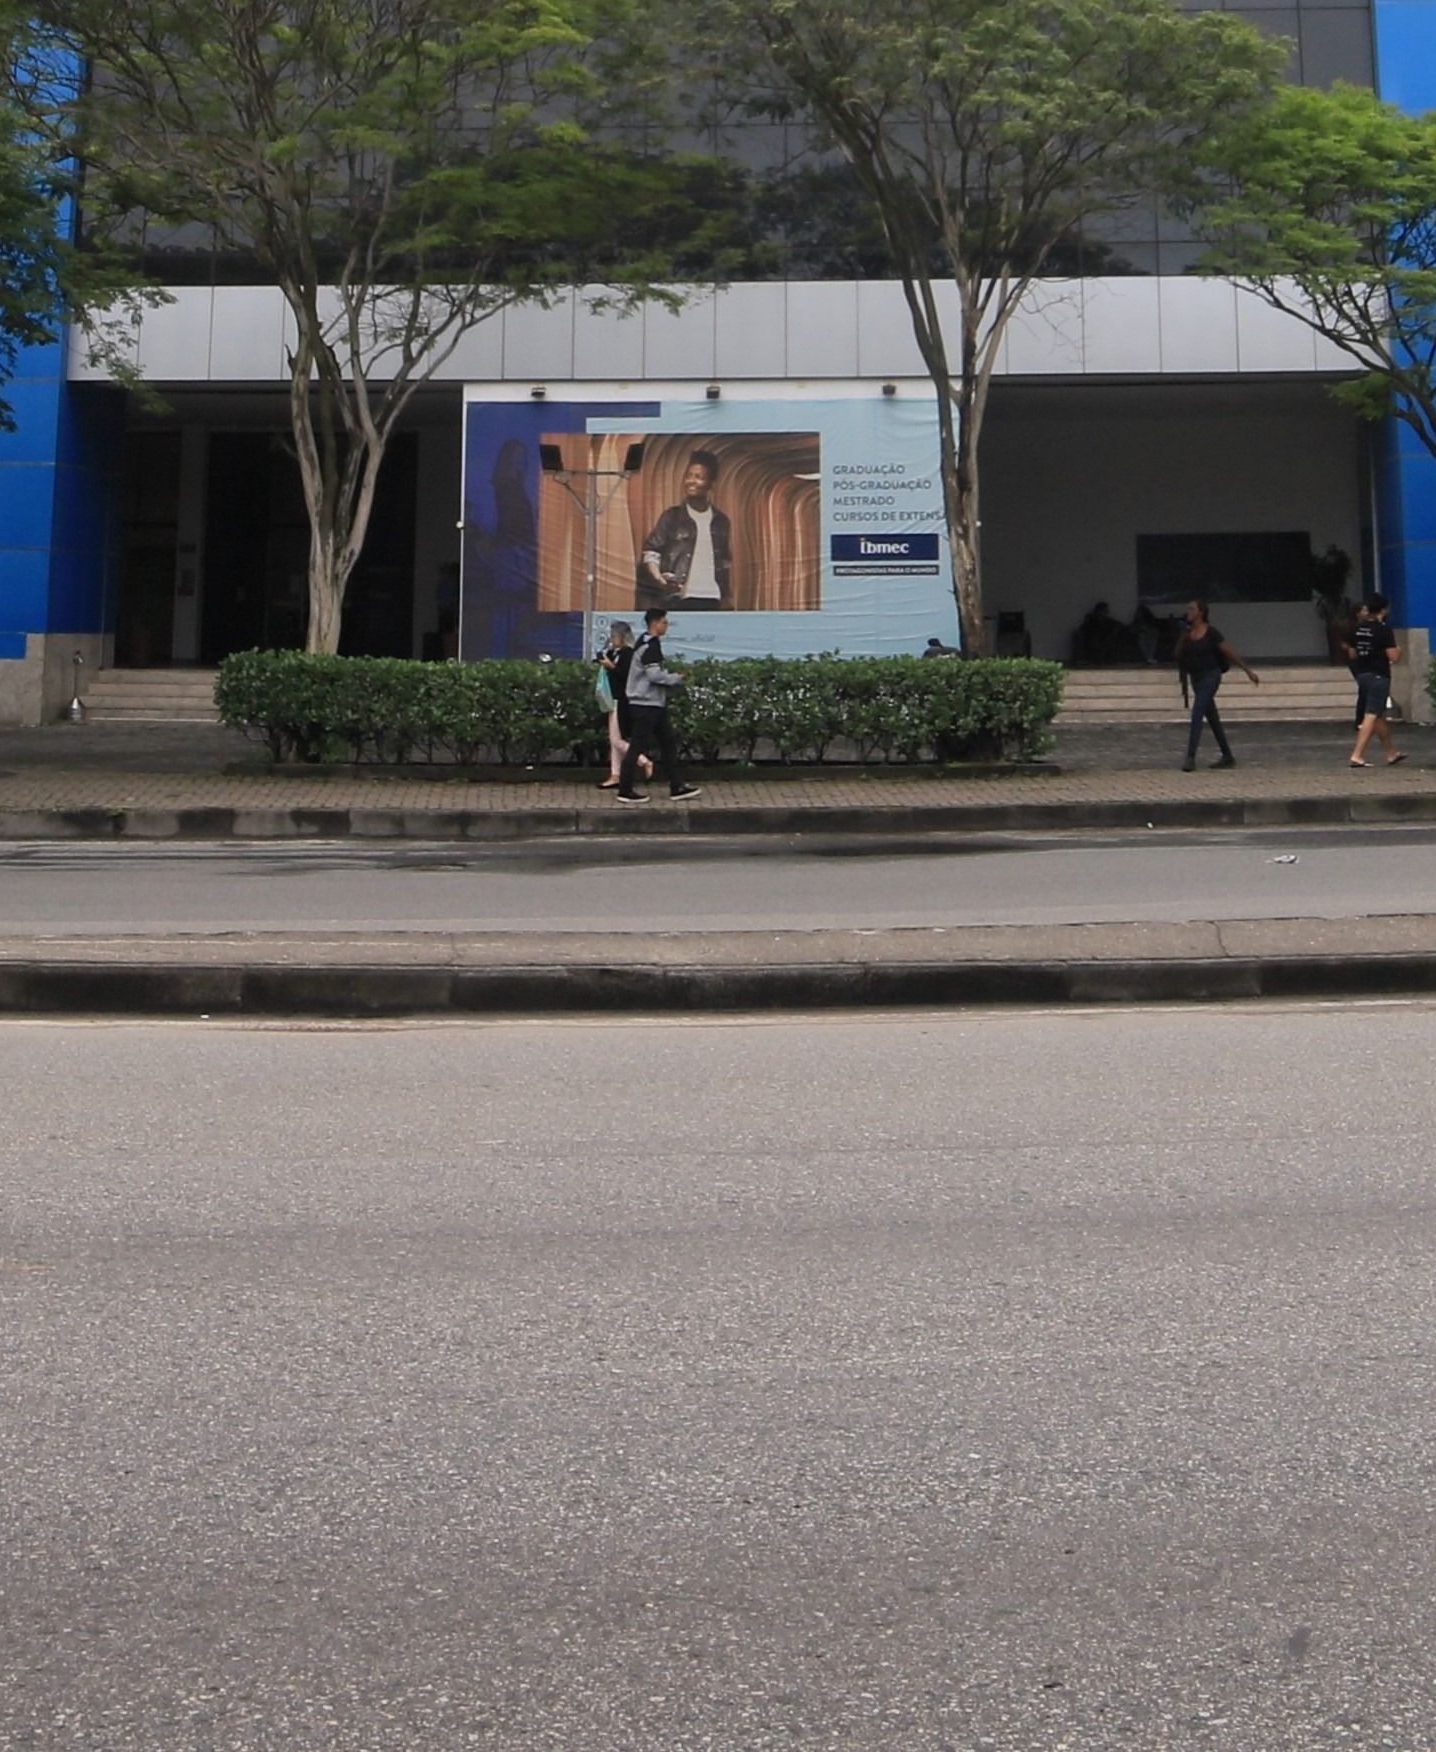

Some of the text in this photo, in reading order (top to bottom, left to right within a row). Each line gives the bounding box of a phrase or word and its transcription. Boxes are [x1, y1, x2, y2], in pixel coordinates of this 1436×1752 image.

[833, 463, 905, 477] GRADUAÇÃO
[833, 479, 931, 491] PÓS-GRADUAÇÃO
[833, 495, 895, 506] MESTRADO
[833, 511, 879, 522] CURSOS
[881, 511, 897, 521] DE
[859, 537, 910, 554] ibmec
